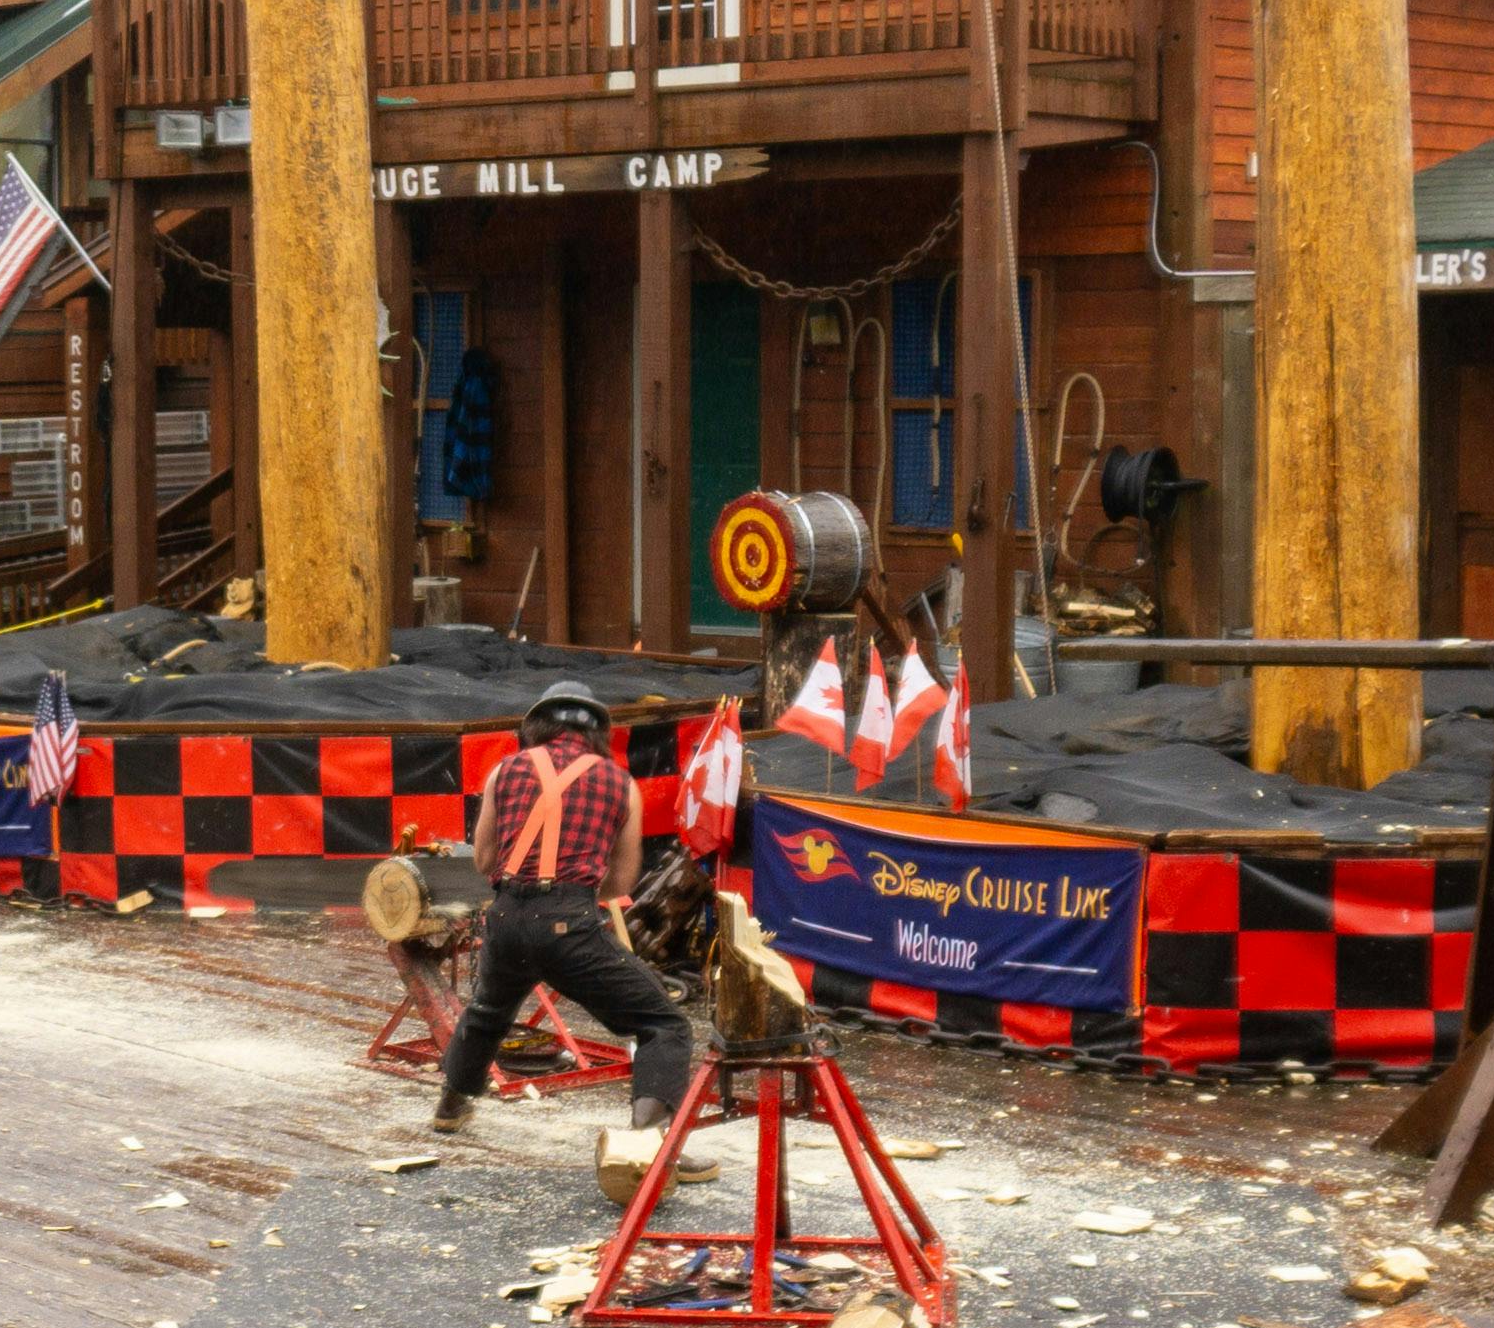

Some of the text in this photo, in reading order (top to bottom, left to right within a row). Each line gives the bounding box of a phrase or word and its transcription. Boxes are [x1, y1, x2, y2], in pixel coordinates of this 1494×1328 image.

[371, 153, 723, 199] UCE MILL CAMP
[70, 334, 85, 546] RESTROOM
[2, 757, 30, 789] LIN
[867, 851, 961, 918] Disney
[965, 866, 1049, 915] CRUISE
[896, 918, 979, 971] Welcome
